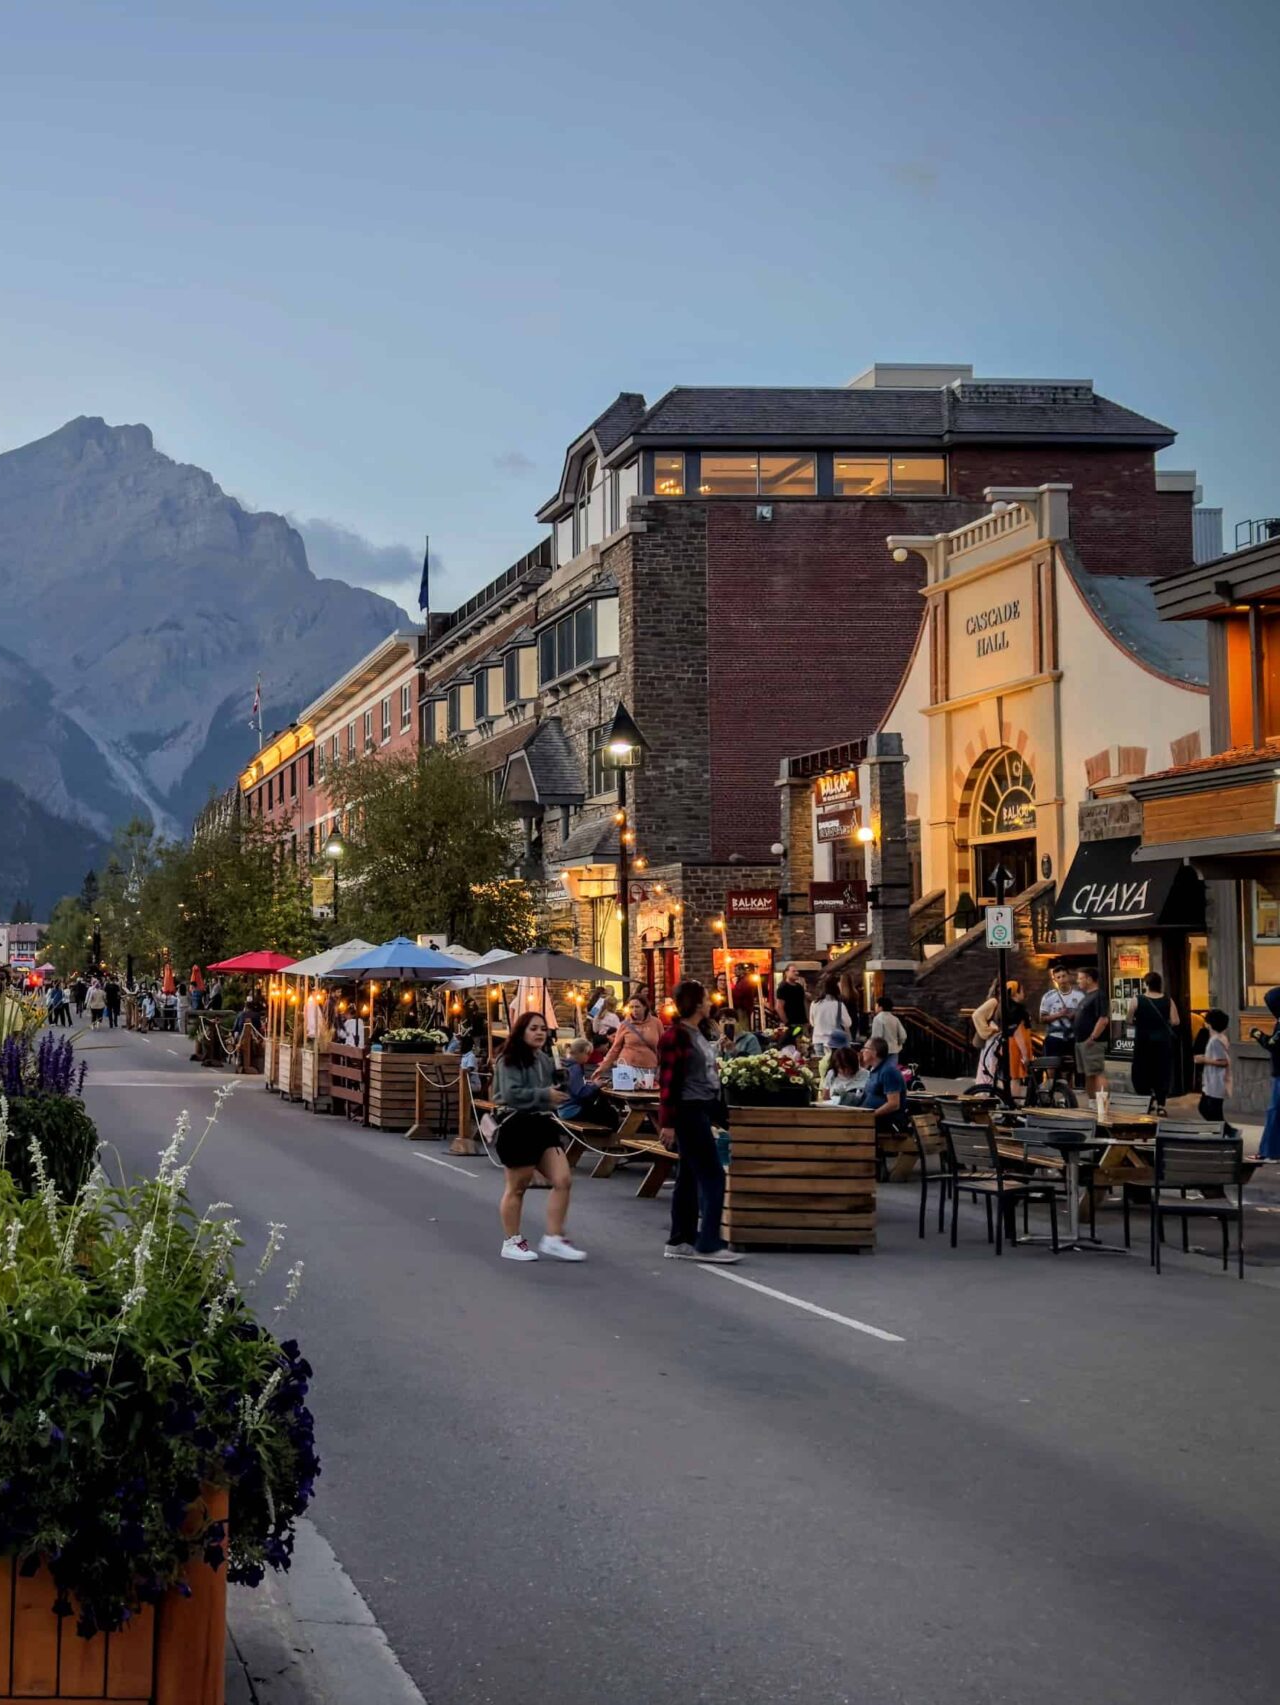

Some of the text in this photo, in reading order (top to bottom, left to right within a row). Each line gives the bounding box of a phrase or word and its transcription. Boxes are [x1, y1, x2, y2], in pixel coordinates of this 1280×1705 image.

[966, 600, 1020, 635] CASCADE
[977, 631, 1009, 657] HALL
[732, 897, 772, 907] BALKAN
[1072, 880, 1149, 913] CHAYA
